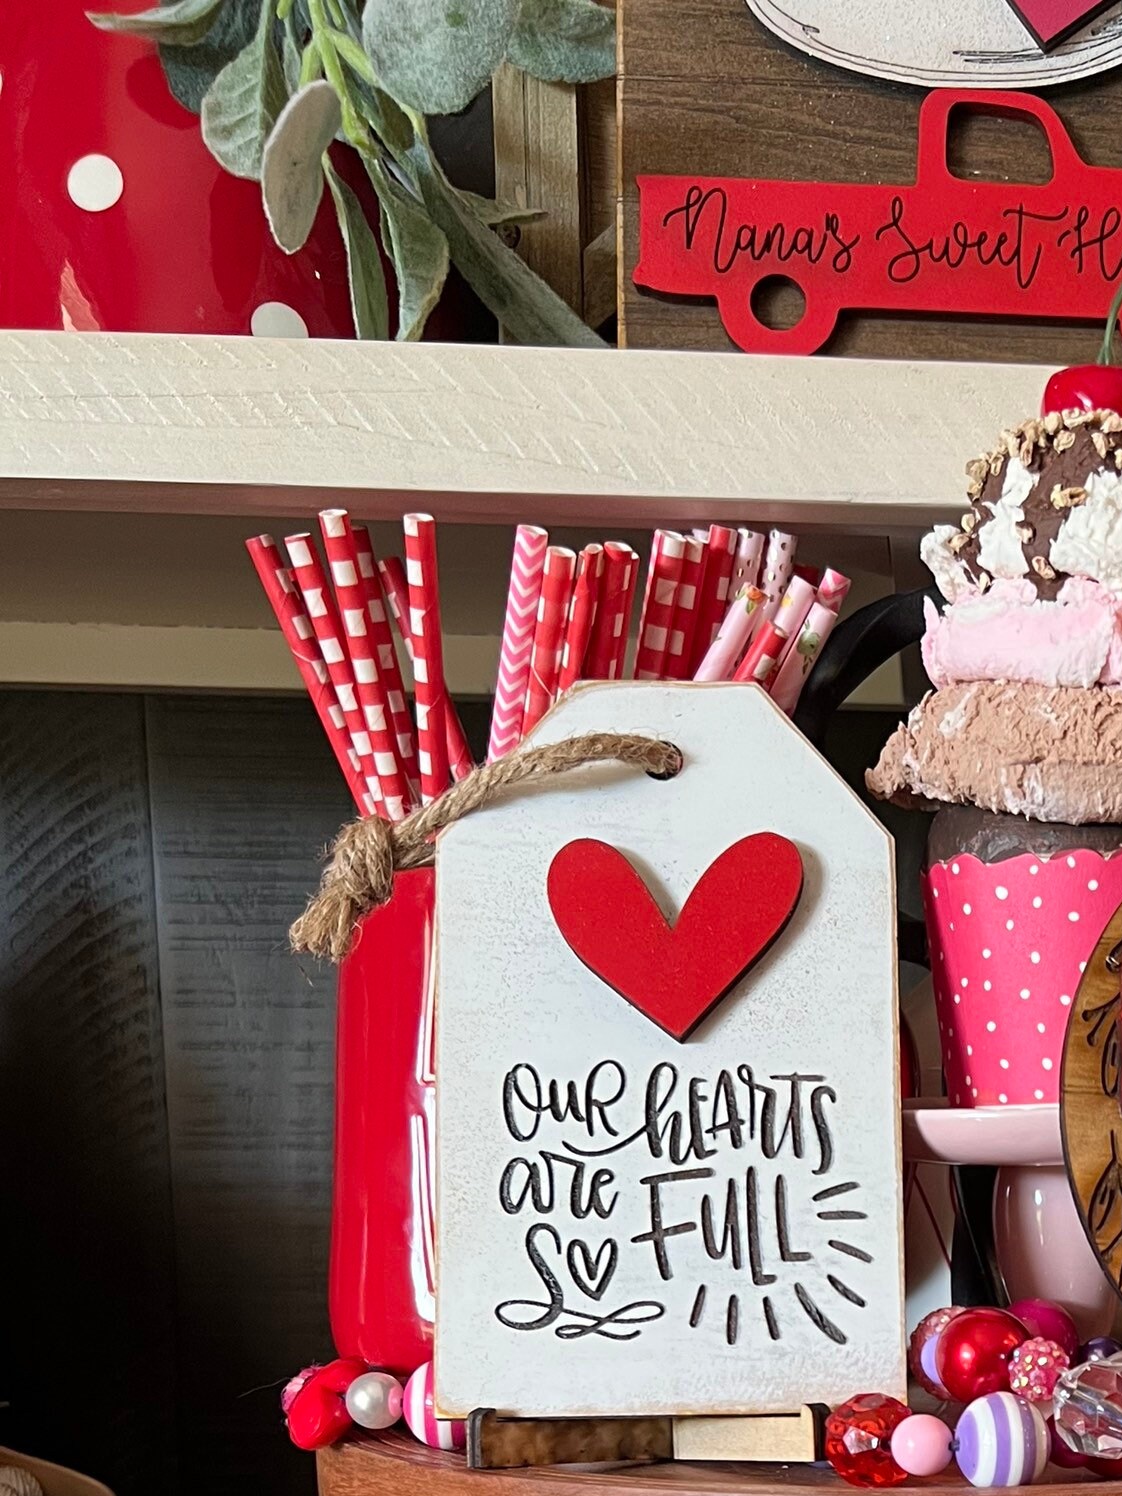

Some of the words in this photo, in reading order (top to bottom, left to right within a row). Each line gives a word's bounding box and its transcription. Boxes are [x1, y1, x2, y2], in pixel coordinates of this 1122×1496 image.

[662, 184, 861, 274] Nana's
[875, 195, 1069, 290] Sweet
[500, 1151, 620, 1220] are
[630, 1165, 813, 1286] FULL
